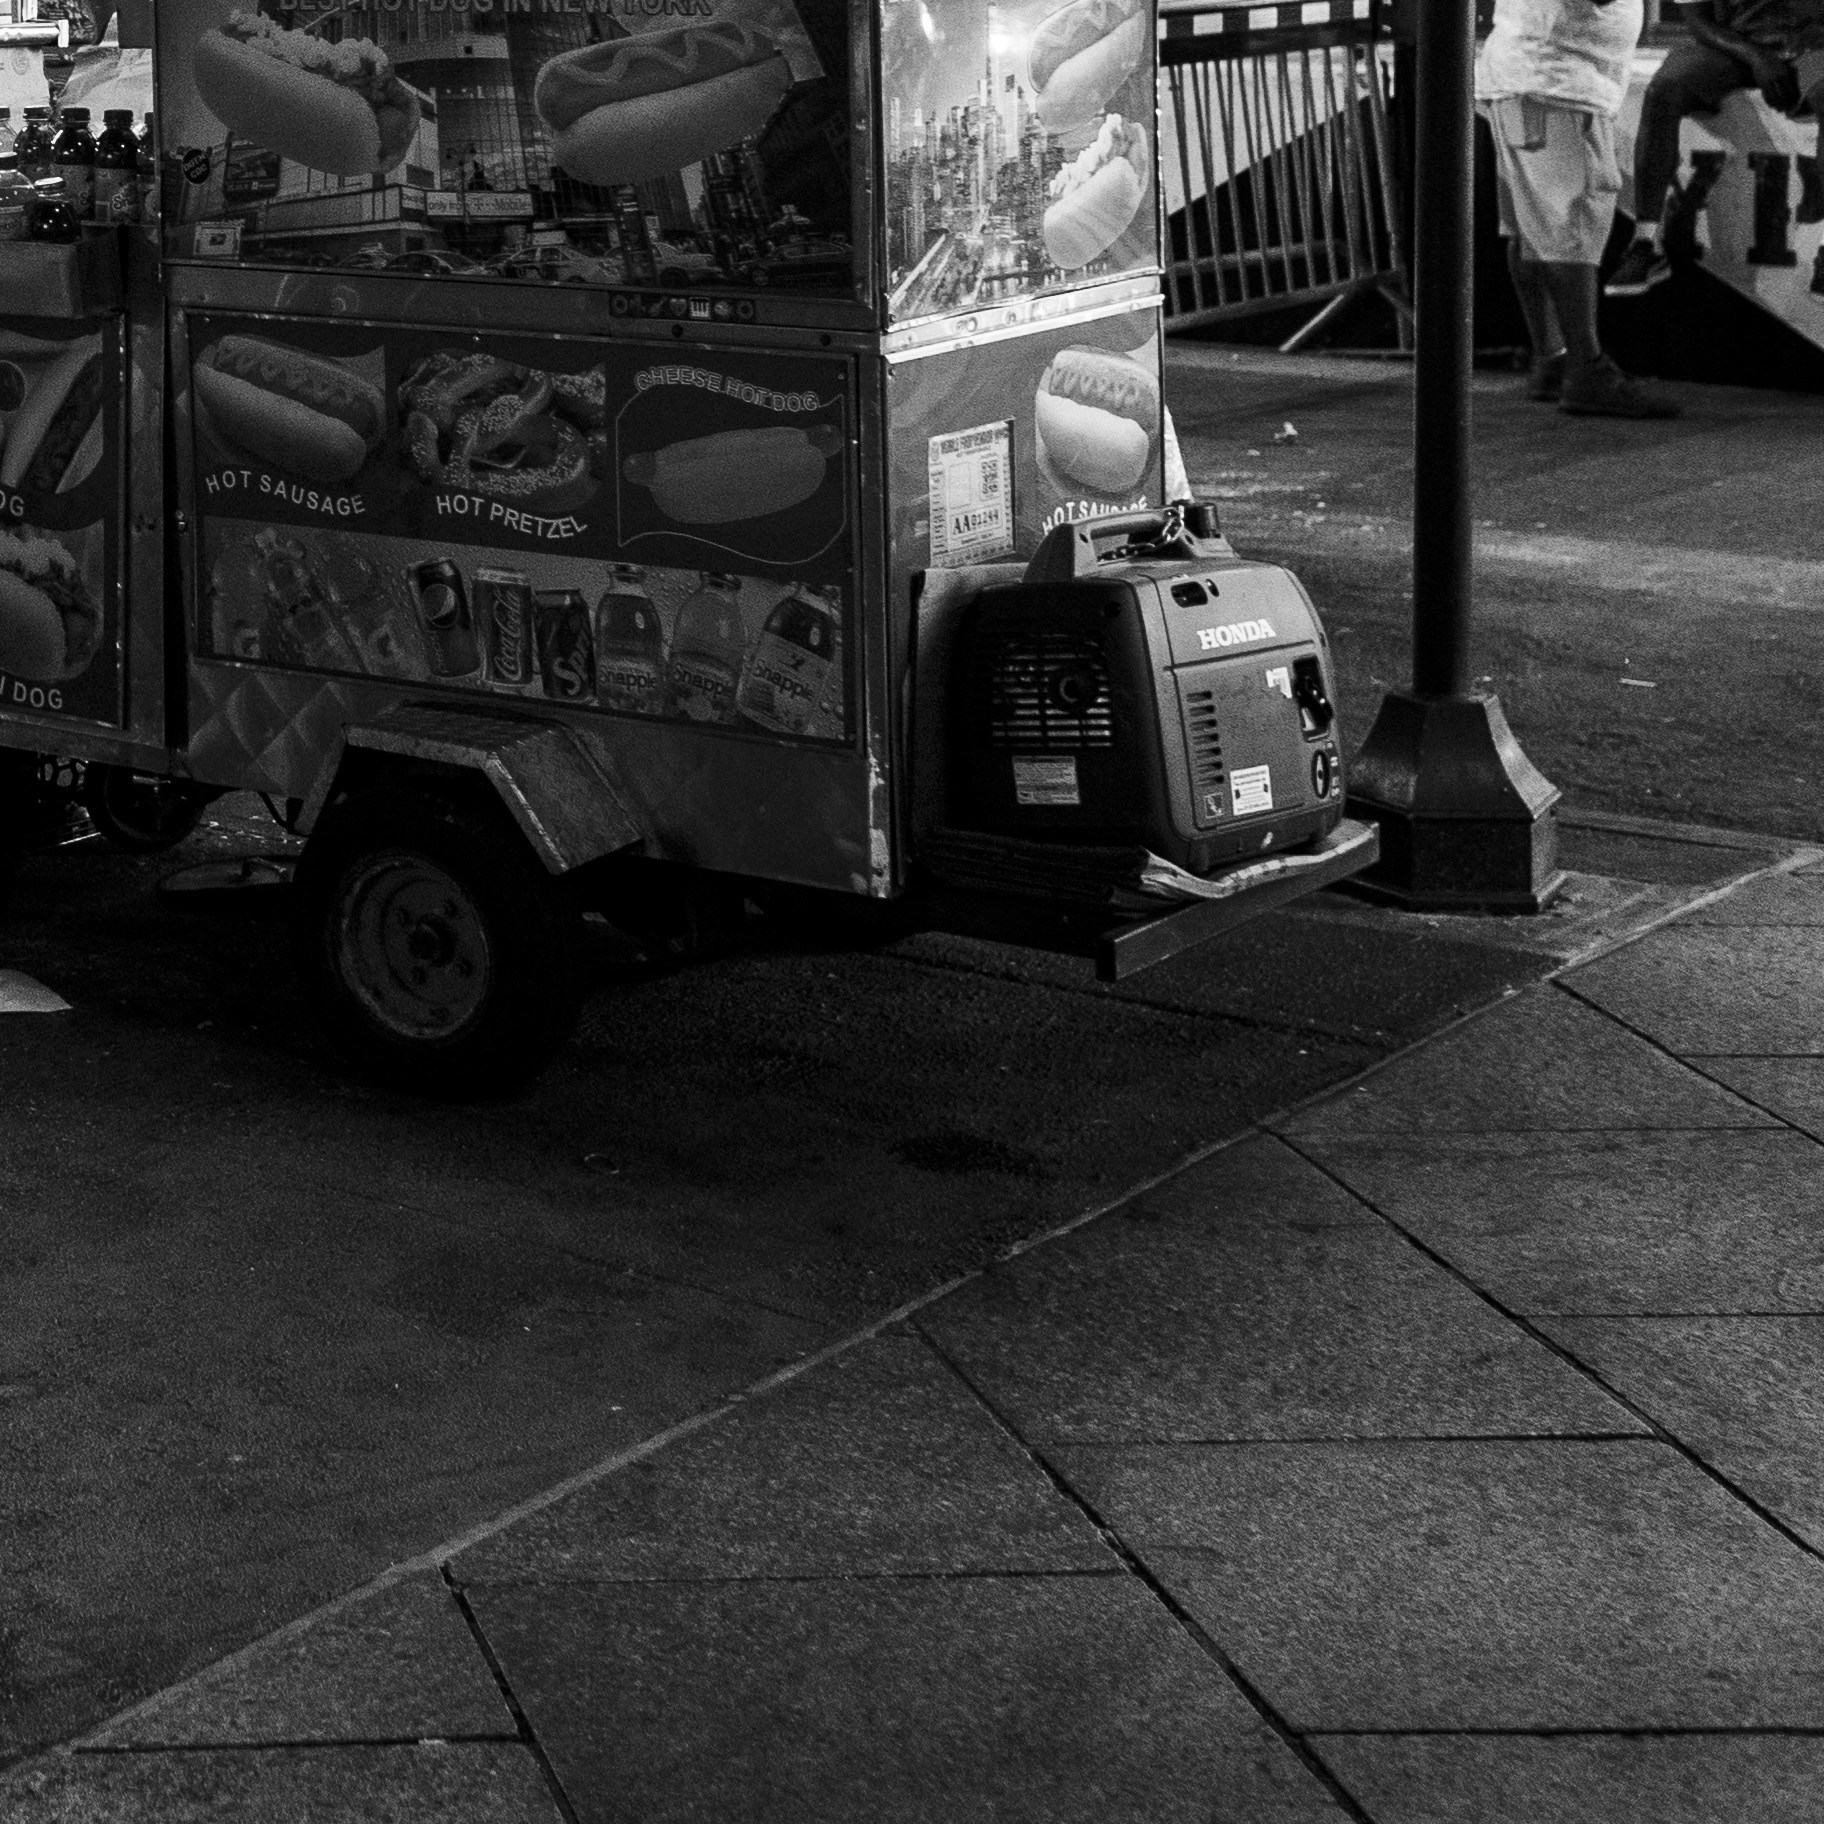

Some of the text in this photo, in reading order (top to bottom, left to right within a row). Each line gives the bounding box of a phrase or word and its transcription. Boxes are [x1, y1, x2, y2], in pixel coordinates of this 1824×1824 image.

[633, 365, 821, 413] CHEESE HOT DOG
[205, 470, 367, 517] HOT SAUSAGE
[436, 494, 589, 540] HOT PRETZEL
[1041, 501, 1076, 536] HOT
[1196, 618, 1277, 650] HONDA
[12, 681, 64, 710] DOG
